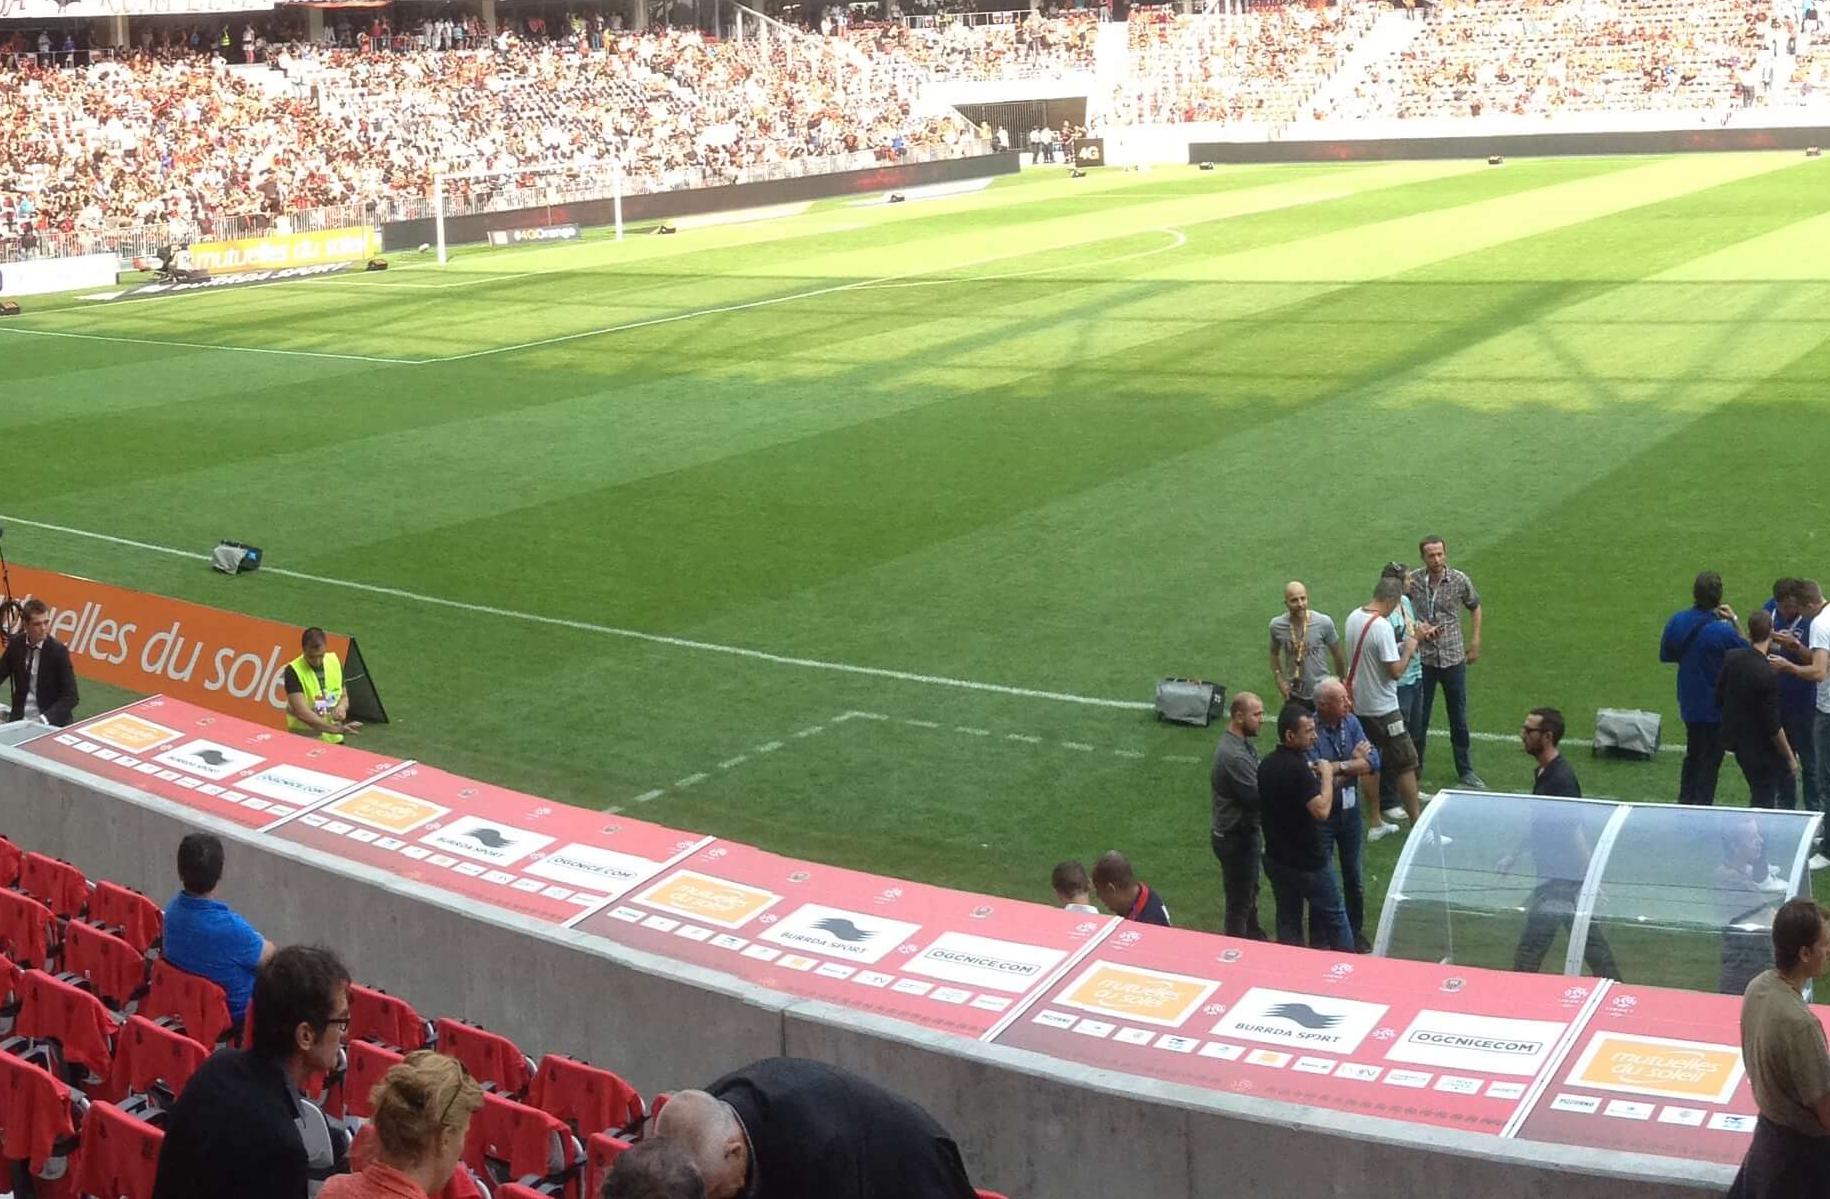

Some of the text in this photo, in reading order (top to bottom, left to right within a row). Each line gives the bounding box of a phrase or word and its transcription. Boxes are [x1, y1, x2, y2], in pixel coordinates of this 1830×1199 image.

[1078, 147, 1100, 160] 4G
[140, 621, 204, 683] du
[204, 645, 289, 709] sole
[780, 931, 869, 955] BURRDA SPORT
[932, 950, 1035, 975] OGCNICE.COM
[1234, 1021, 1293, 1038] BURRDA
[1609, 1050, 1722, 1074] mutuelles
[1610, 1062, 1706, 1083] du soleil
